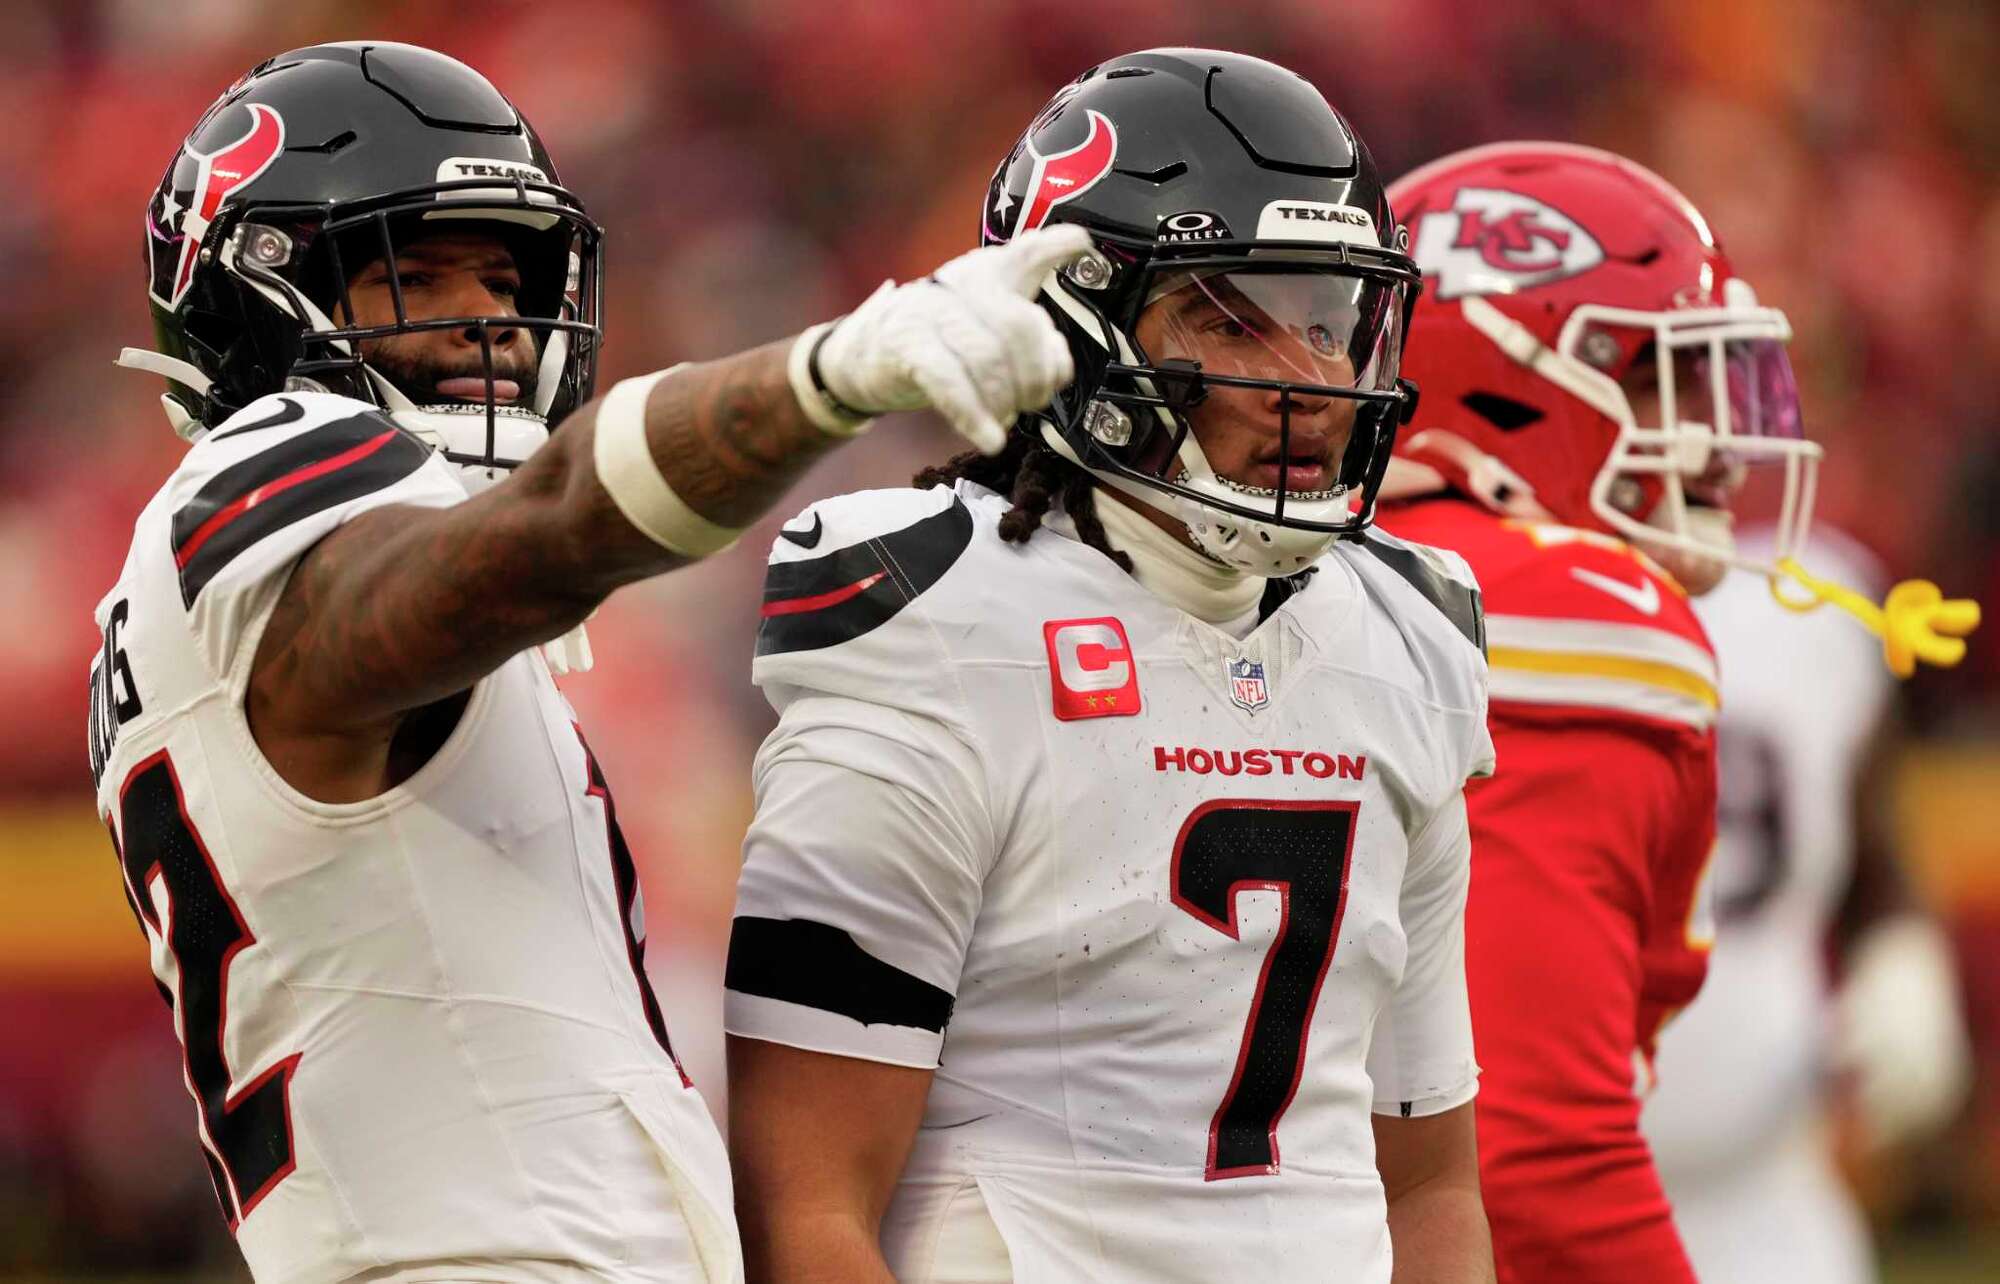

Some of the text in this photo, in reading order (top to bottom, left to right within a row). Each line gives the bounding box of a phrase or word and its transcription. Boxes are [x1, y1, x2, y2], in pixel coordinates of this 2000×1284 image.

[1157, 228, 1224, 242] OAKLEY
[1276, 207, 1369, 227] TEXANS
[1453, 209, 1571, 274] KC
[1054, 623, 1131, 693] C
[1235, 679, 1265, 703] NFL
[1153, 745, 1367, 781] HOUSTON
[1169, 798, 1362, 1182] 7
